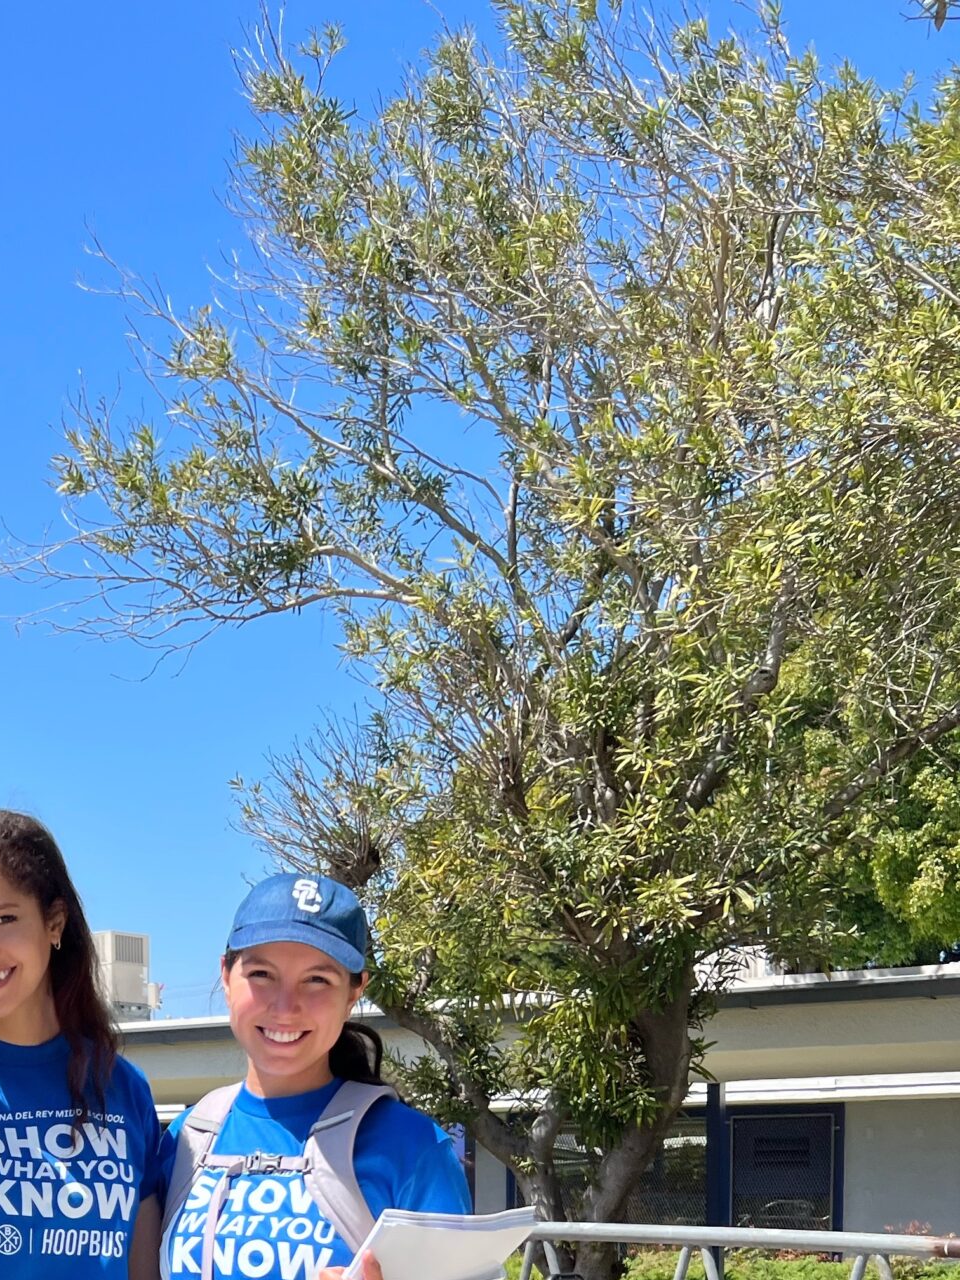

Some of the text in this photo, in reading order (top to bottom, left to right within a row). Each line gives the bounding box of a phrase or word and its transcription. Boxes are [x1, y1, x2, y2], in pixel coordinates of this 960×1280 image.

[15, 1111, 33, 1120] DEL
[35, 1109, 54, 1118] REY
[77, 1160, 134, 1183] YOU
[41, 1228, 125, 1257] HOOPBUS
[269, 1216, 335, 1244] YOU
